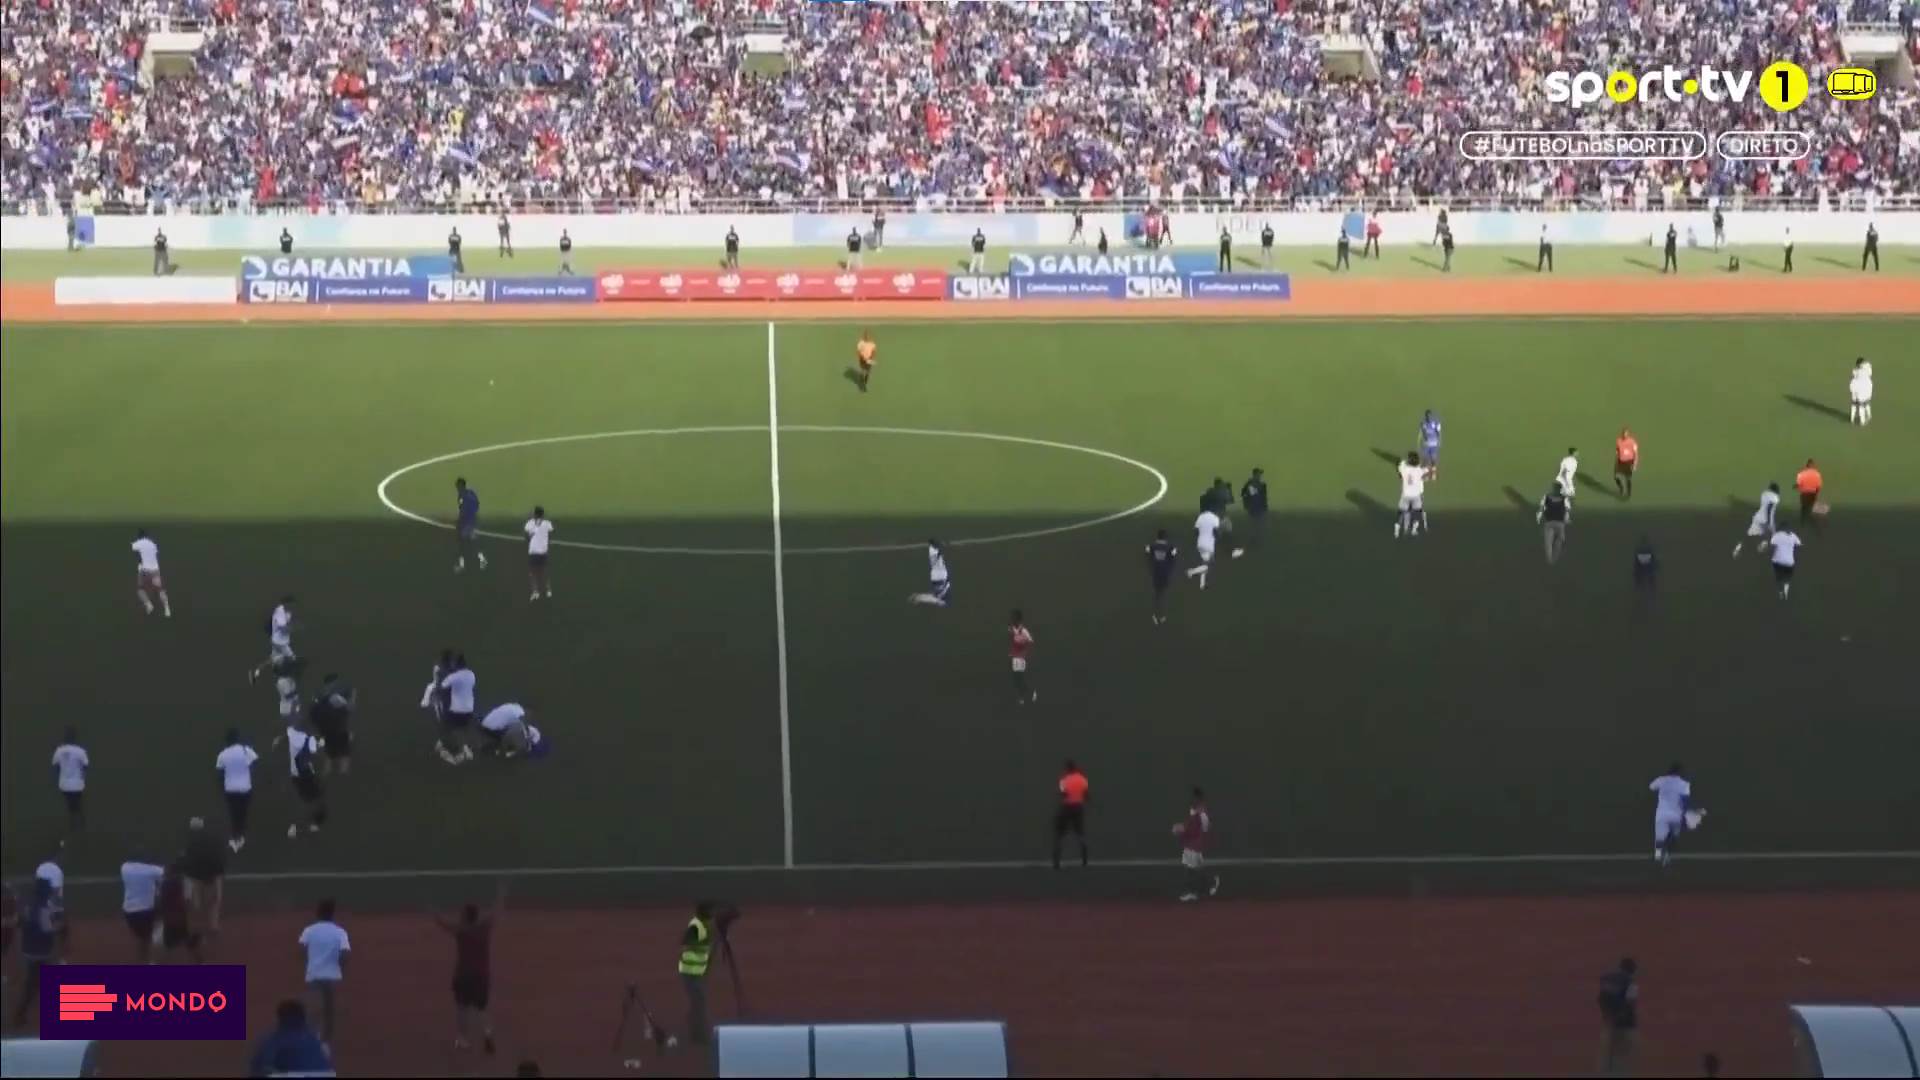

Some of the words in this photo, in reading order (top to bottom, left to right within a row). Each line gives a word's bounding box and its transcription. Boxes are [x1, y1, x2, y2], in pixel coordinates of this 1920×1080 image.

[272, 257, 411, 278] GARANTIA
[1039, 255, 1176, 275] GARANTIA
[276, 281, 308, 297] BAI
[455, 279, 486, 296] BAI
